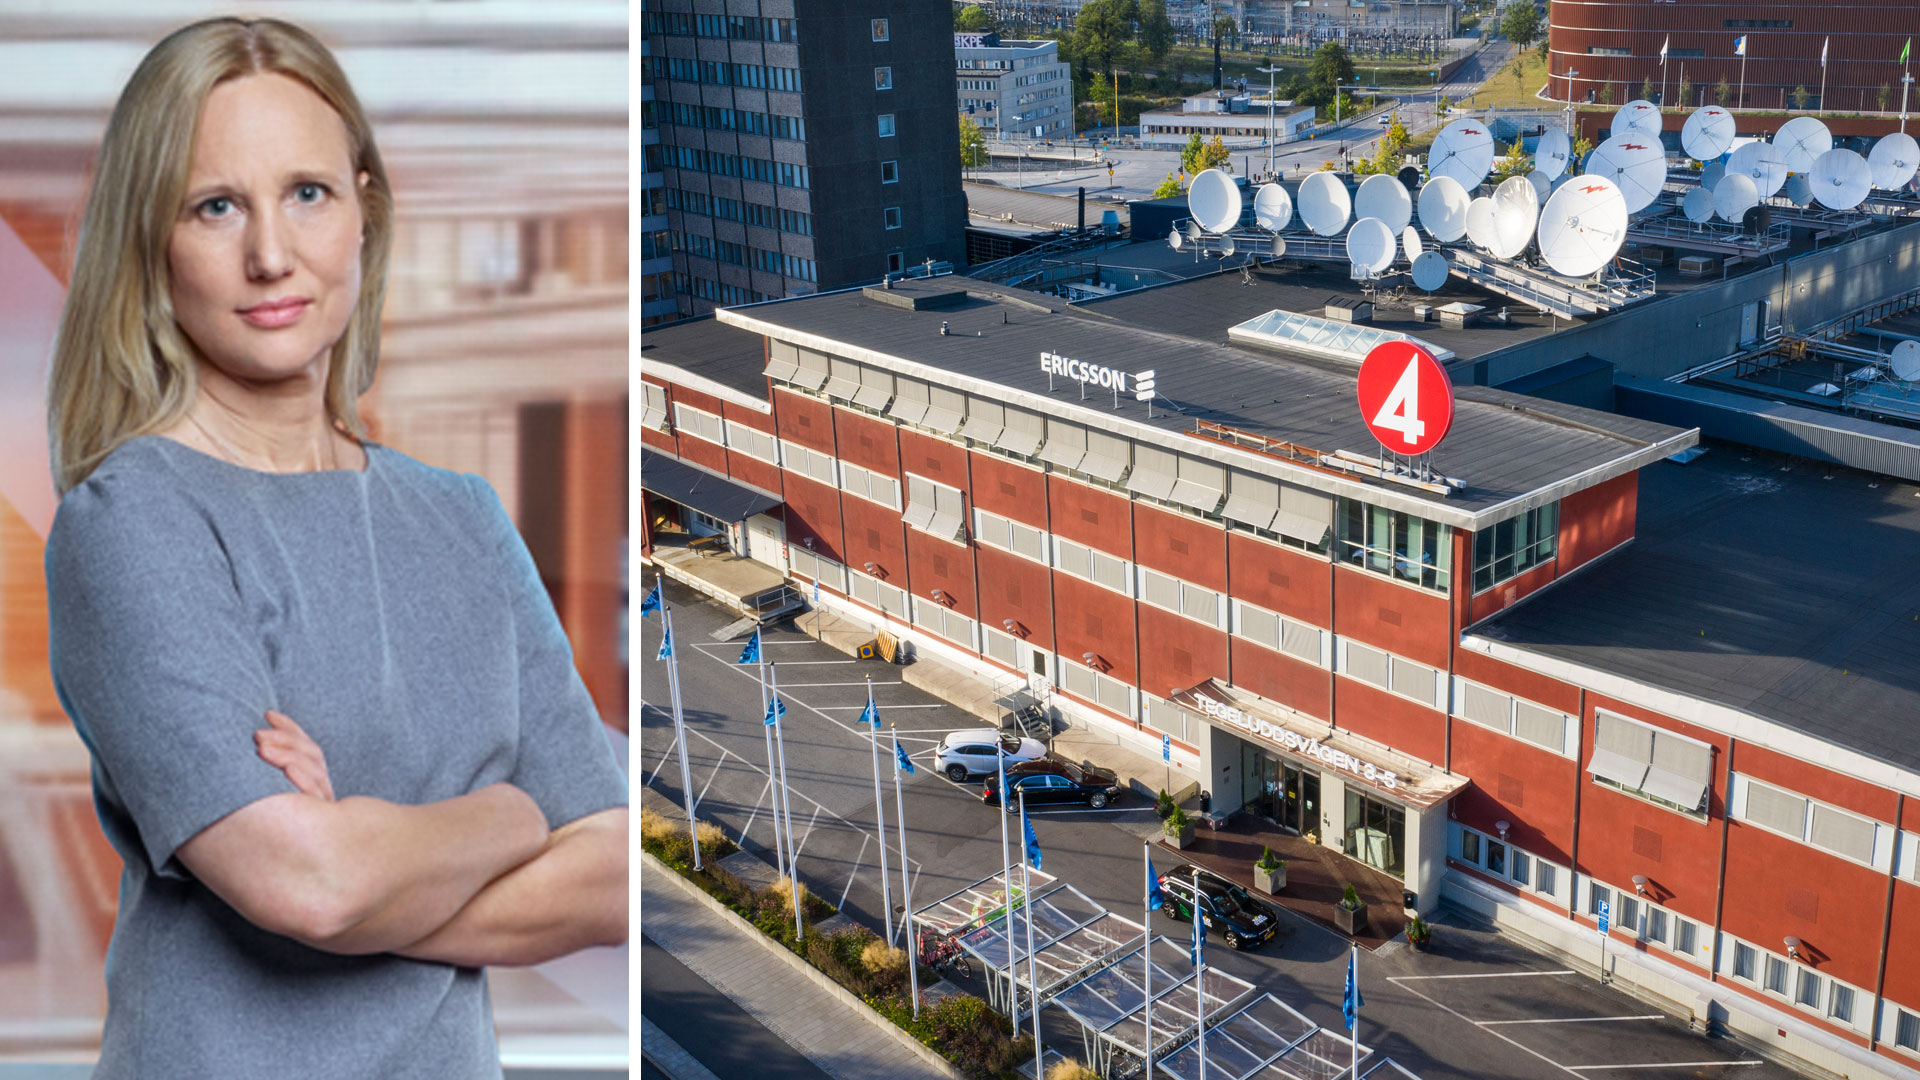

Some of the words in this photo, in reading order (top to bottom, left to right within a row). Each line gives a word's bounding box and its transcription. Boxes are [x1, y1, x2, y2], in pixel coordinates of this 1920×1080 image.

[1040, 351, 1126, 392] ERICSSON
[1372, 352, 1425, 445] 4
[1364, 763, 1398, 789] 3-5
[1601, 902, 1608, 912] P
